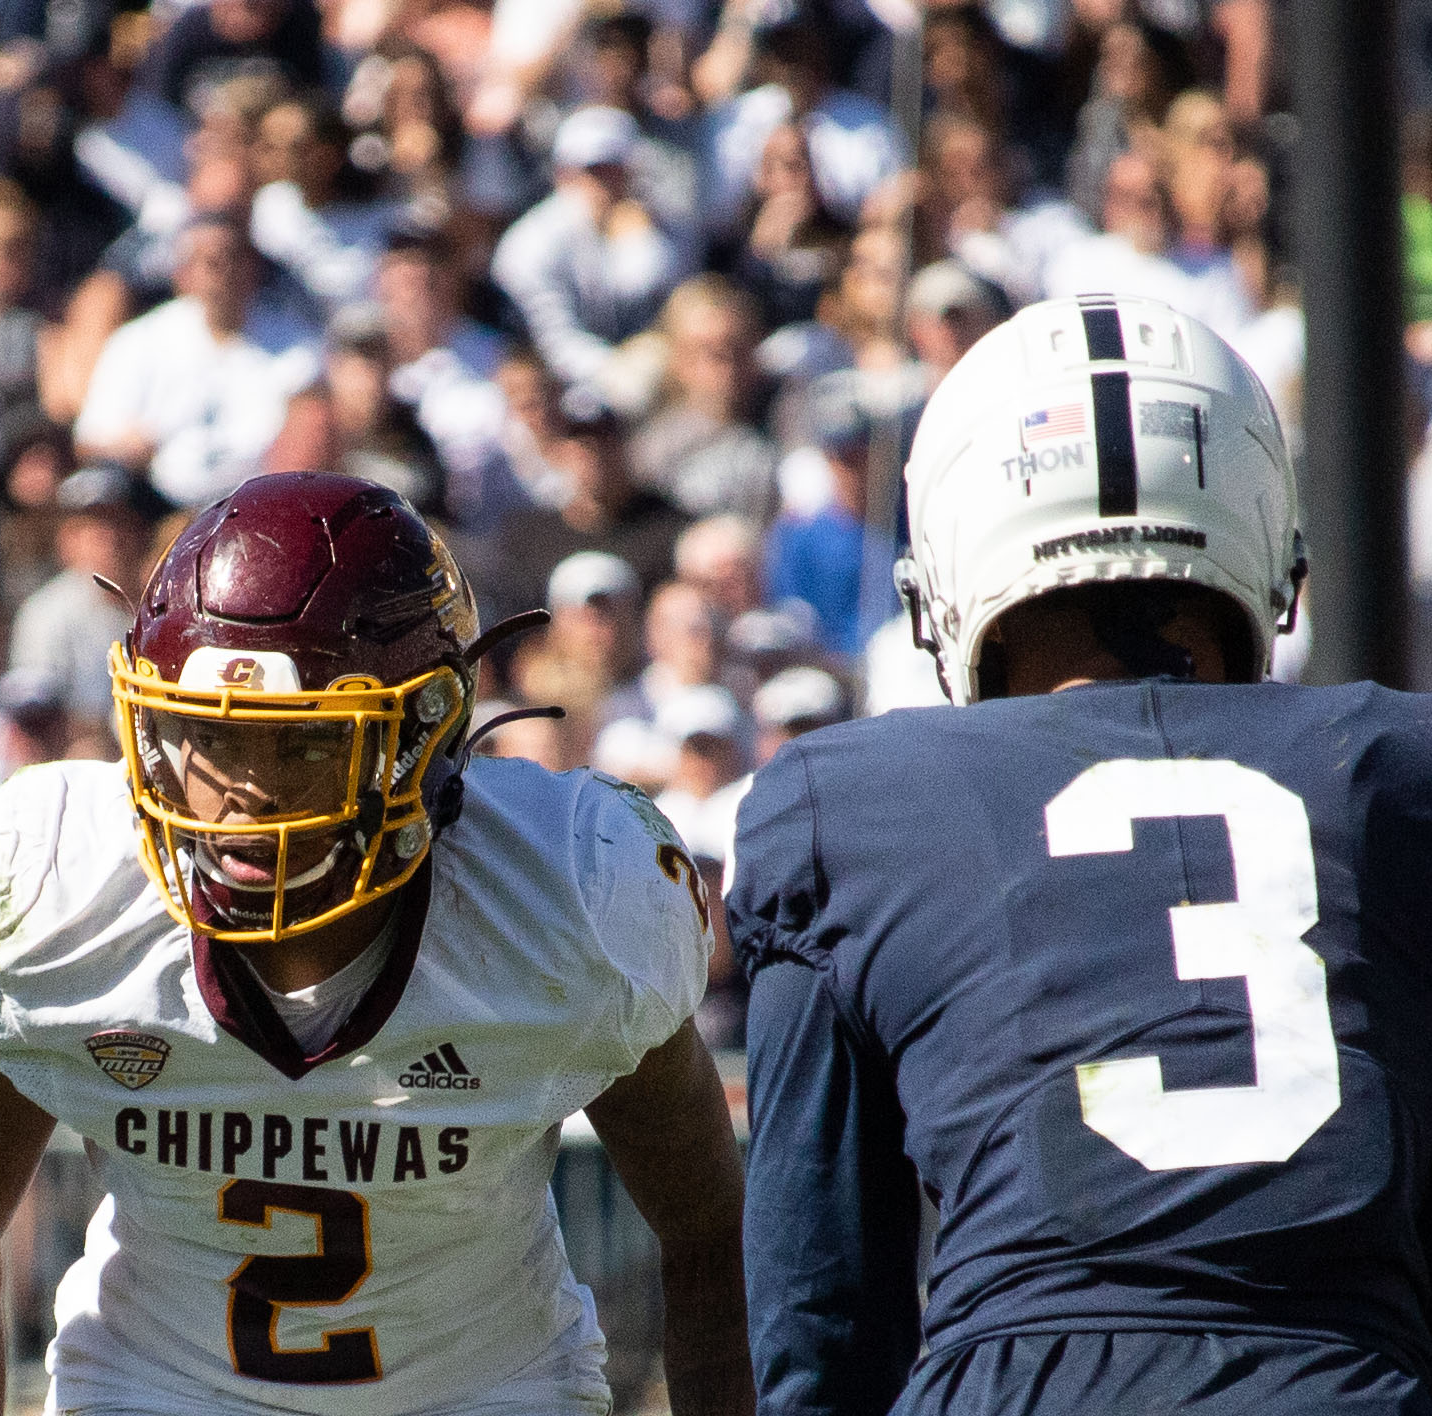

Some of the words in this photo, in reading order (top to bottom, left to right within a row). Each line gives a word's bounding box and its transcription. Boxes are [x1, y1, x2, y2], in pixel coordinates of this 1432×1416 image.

[1001, 442, 1085, 481] THON
[1032, 525, 1136, 563] NITTANY
[1140, 525, 1208, 550] LIONS
[217, 656, 259, 685] C
[389, 730, 431, 786] iddell
[1044, 757, 1342, 1172] 3
[101, 1059, 161, 1074] MAC
[397, 1071, 482, 1091] adidas
[114, 1106, 471, 1184] CHIPPEWAS
[216, 1177, 384, 1386] 2
